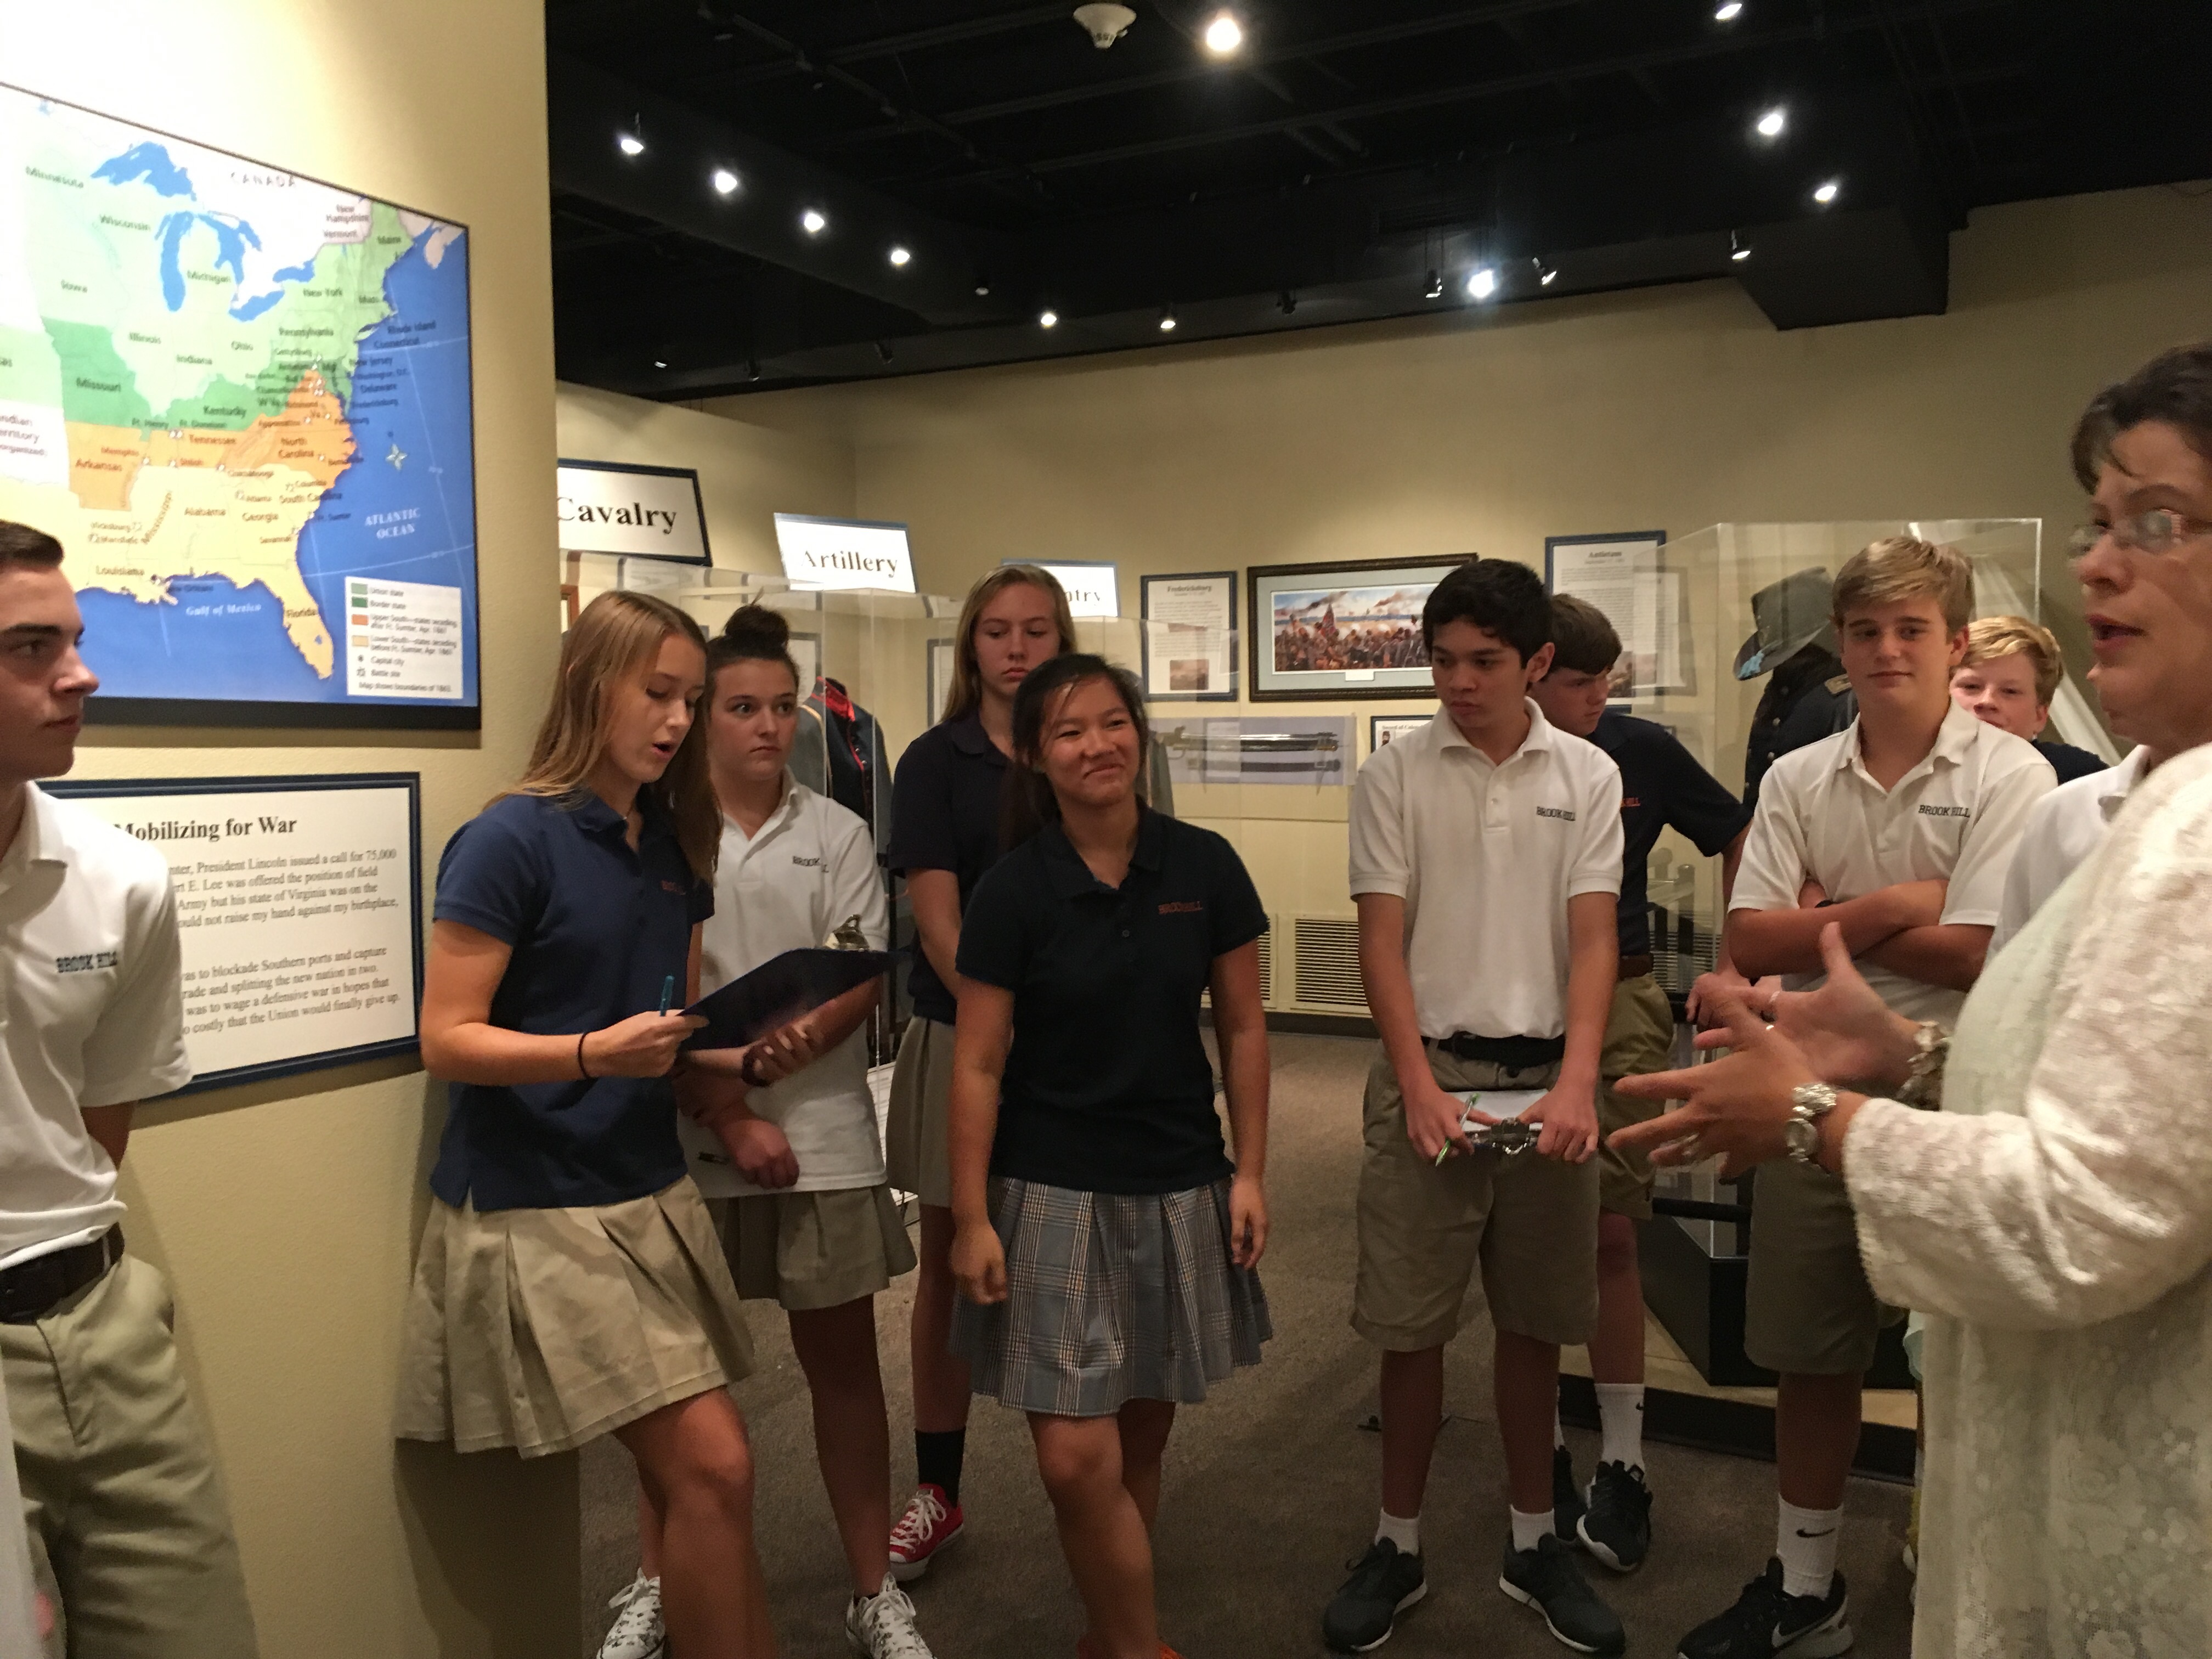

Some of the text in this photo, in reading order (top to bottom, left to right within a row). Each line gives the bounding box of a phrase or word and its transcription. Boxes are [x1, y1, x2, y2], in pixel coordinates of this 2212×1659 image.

[0, 414, 33, 426] ndian
[0, 430, 40, 444] erritory
[364, 507, 421, 527] ATLANTIC
[557, 496, 677, 535] Cavalry
[376, 523, 416, 540] OCEAN
[800, 549, 898, 579] Artillery
[1065, 588, 1101, 607] ntry
[1537, 806, 1562, 818] BROOK
[1918, 804, 1950, 816] BROOK
[225, 817, 253, 836] for
[257, 815, 298, 834] War
[196, 860, 246, 874] President
[247, 856, 287, 870] Lincoln
[791, 855, 821, 867] BROOK
[202, 879, 224, 891] Lee
[248, 872, 285, 887] offered
[286, 872, 302, 884] the
[304, 870, 343, 885] position
[248, 893, 273, 904] state
[287, 886, 327, 902] Virginia
[178, 915, 202, 928] ould
[270, 906, 296, 919] hand
[297, 903, 332, 919] against
[211, 961, 259, 978] blockade
[261, 956, 307, 972] Southern
[308, 953, 333, 968] ports
[182, 985, 207, 1000] rade
[209, 982, 228, 996] and
[230, 978, 274, 996] splitting
[274, 974, 291, 986] the
[292, 974, 313, 984] new
[314, 967, 346, 981] nation
[222, 999, 251, 1012] wage
[261, 989, 309, 1005] defensive
[342, 982, 371, 995] hopes
[192, 1018, 224, 1034] costly
[227, 1015, 248, 1028] that
[249, 1012, 266, 1025] the
[268, 1007, 300, 1021] Union
[301, 1001, 331, 1015] would
[332, 996, 363, 1011] finally
